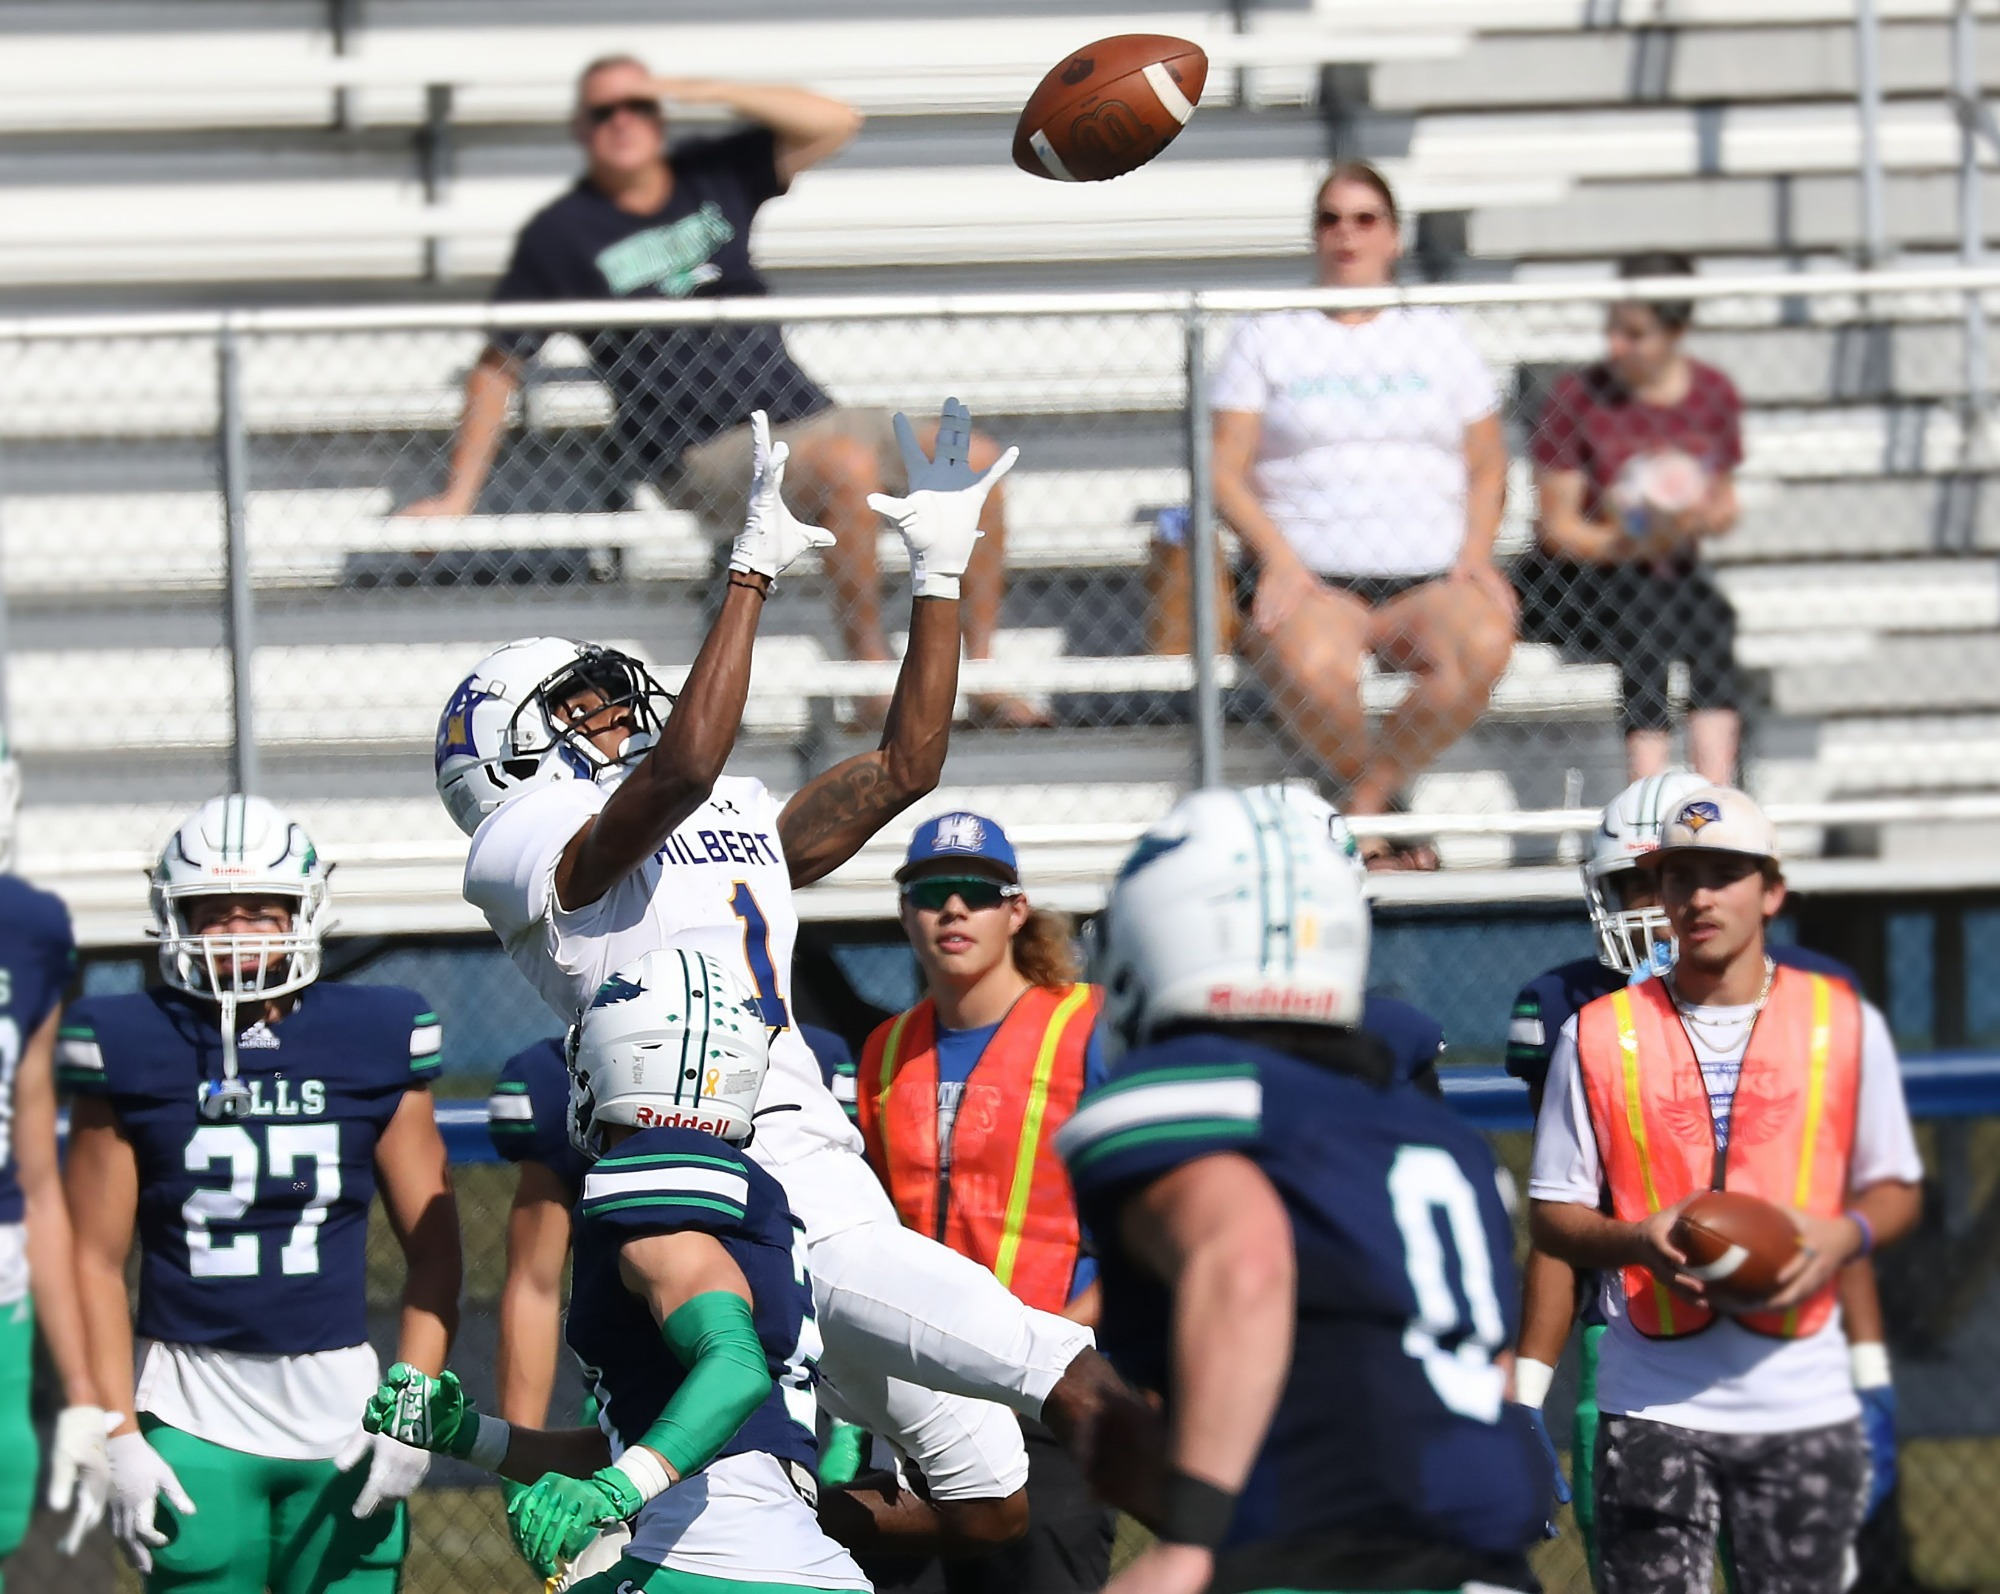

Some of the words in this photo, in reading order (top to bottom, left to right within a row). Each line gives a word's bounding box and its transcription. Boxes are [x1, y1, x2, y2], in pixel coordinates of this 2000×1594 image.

[654, 830, 779, 865] HILBERT
[726, 879, 790, 1031] 1
[635, 1106, 731, 1137] Riddell
[182, 1123, 341, 1278] 27
[1386, 1143, 1506, 1425] 0
